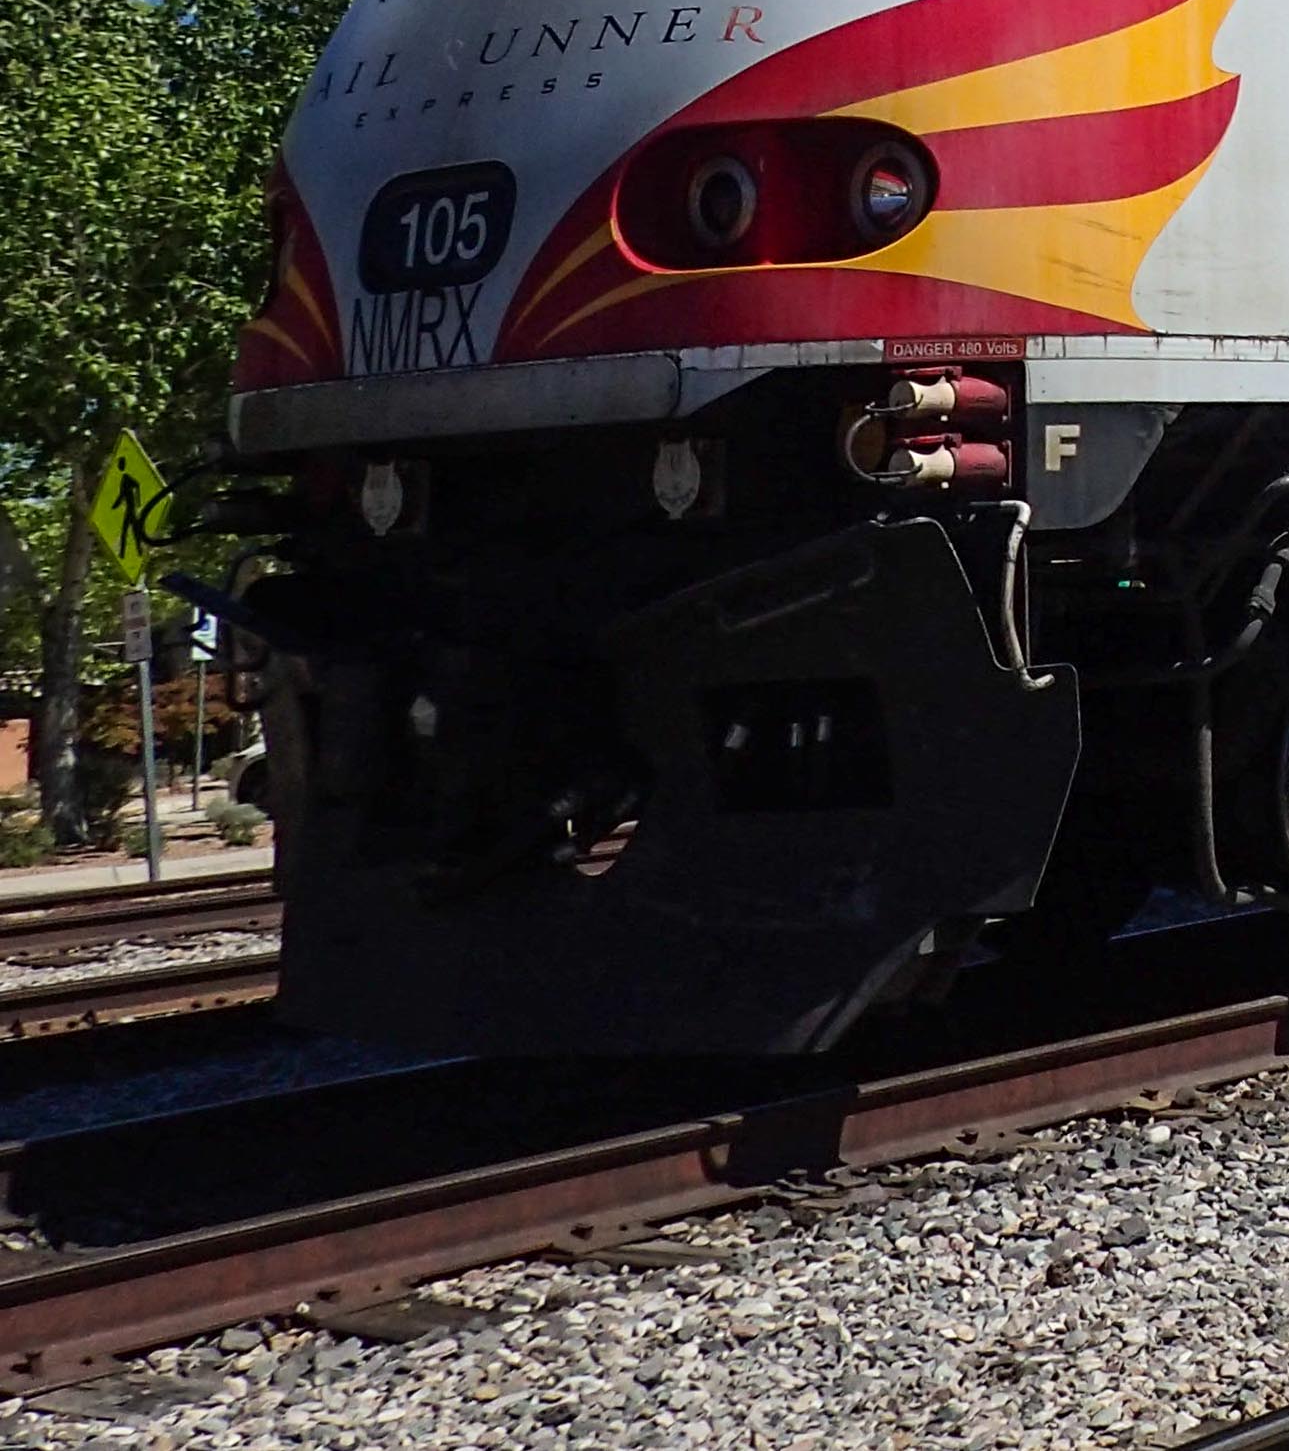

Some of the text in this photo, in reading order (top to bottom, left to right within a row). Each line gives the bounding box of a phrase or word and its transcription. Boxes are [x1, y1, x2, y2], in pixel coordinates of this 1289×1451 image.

[355, 72, 603, 128] EXPRESS
[400, 191, 489, 268] 105
[350, 282, 485, 375] NMRX
[893, 341, 1018, 357] DANGER 480 Volts
[1045, 424, 1080, 471] F
